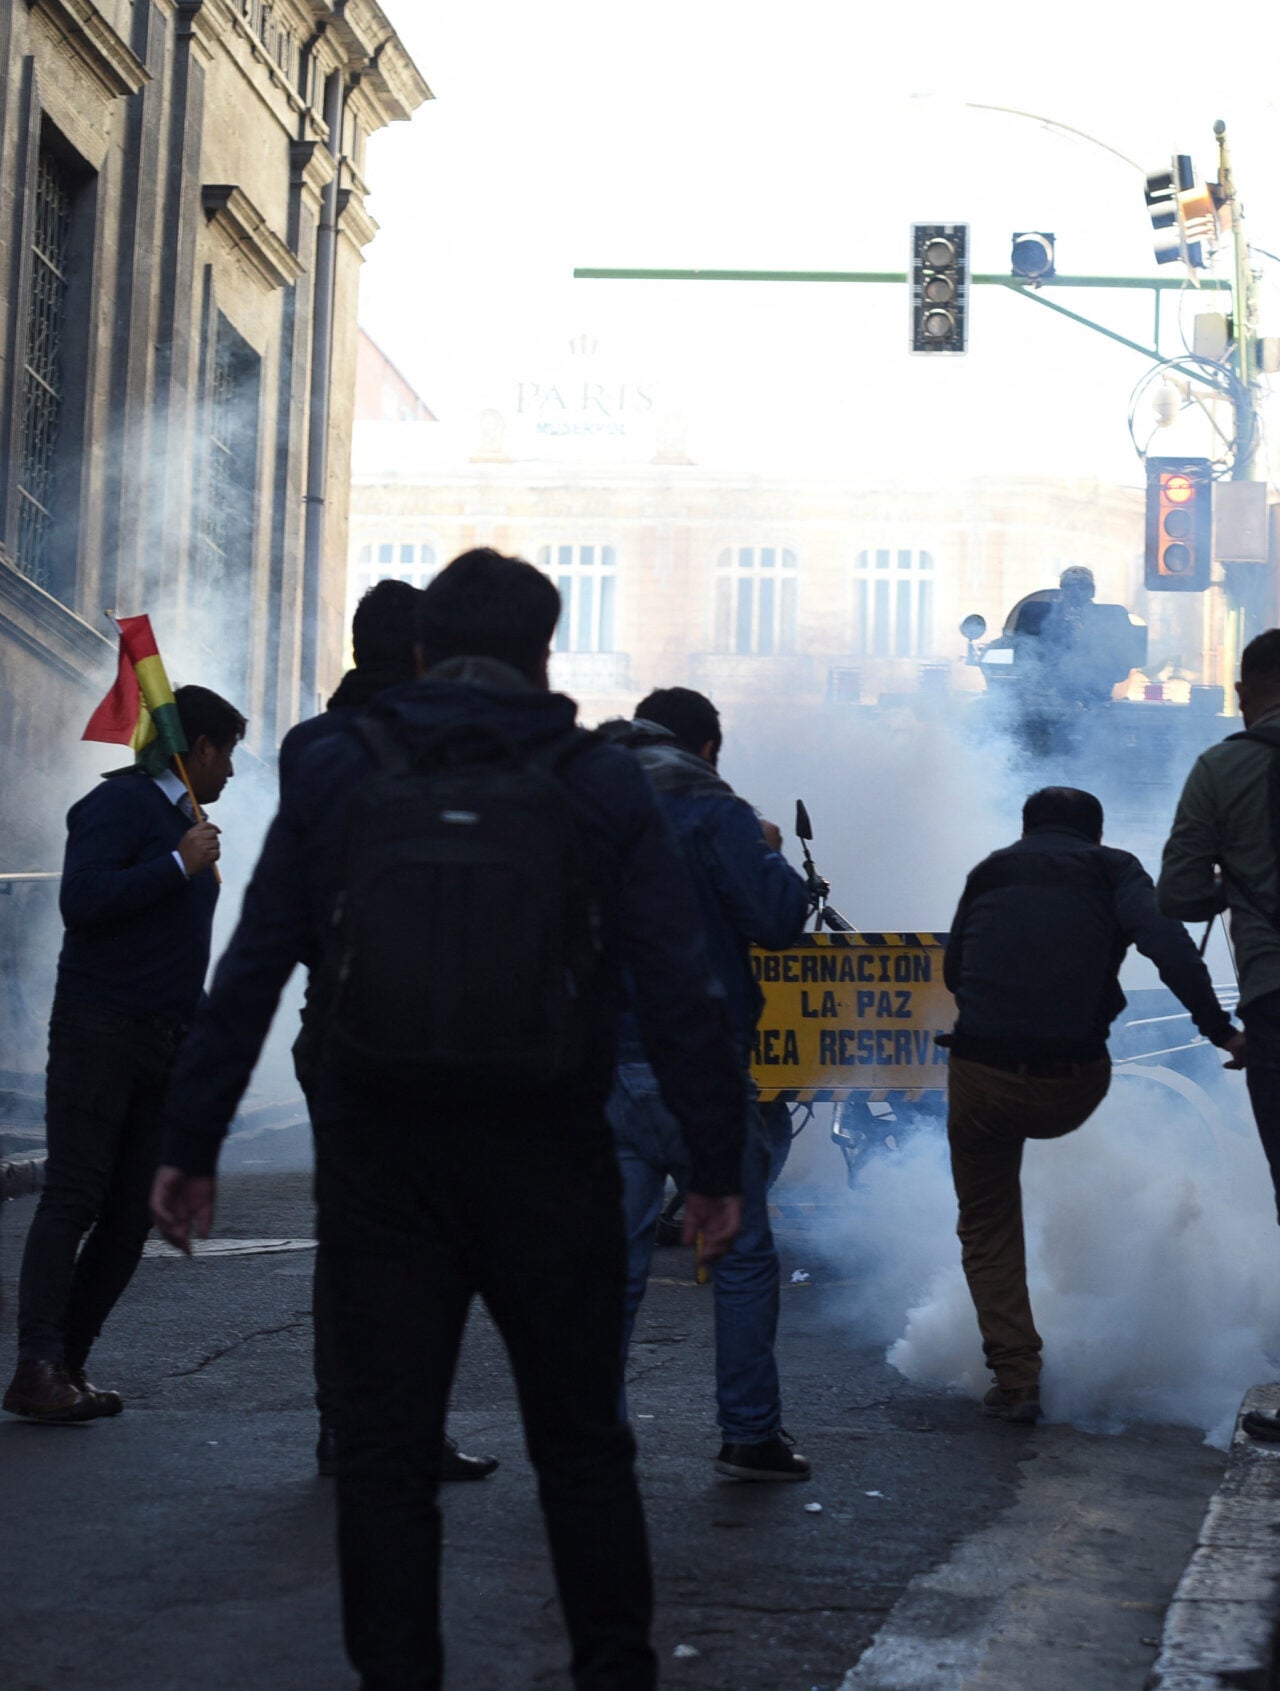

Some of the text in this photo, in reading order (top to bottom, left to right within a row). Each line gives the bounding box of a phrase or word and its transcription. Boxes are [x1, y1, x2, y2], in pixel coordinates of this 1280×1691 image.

[517, 381, 654, 417] PARIS
[801, 990, 912, 1019] LA PAZ
[750, 1029, 949, 1066] REA RESERVA
